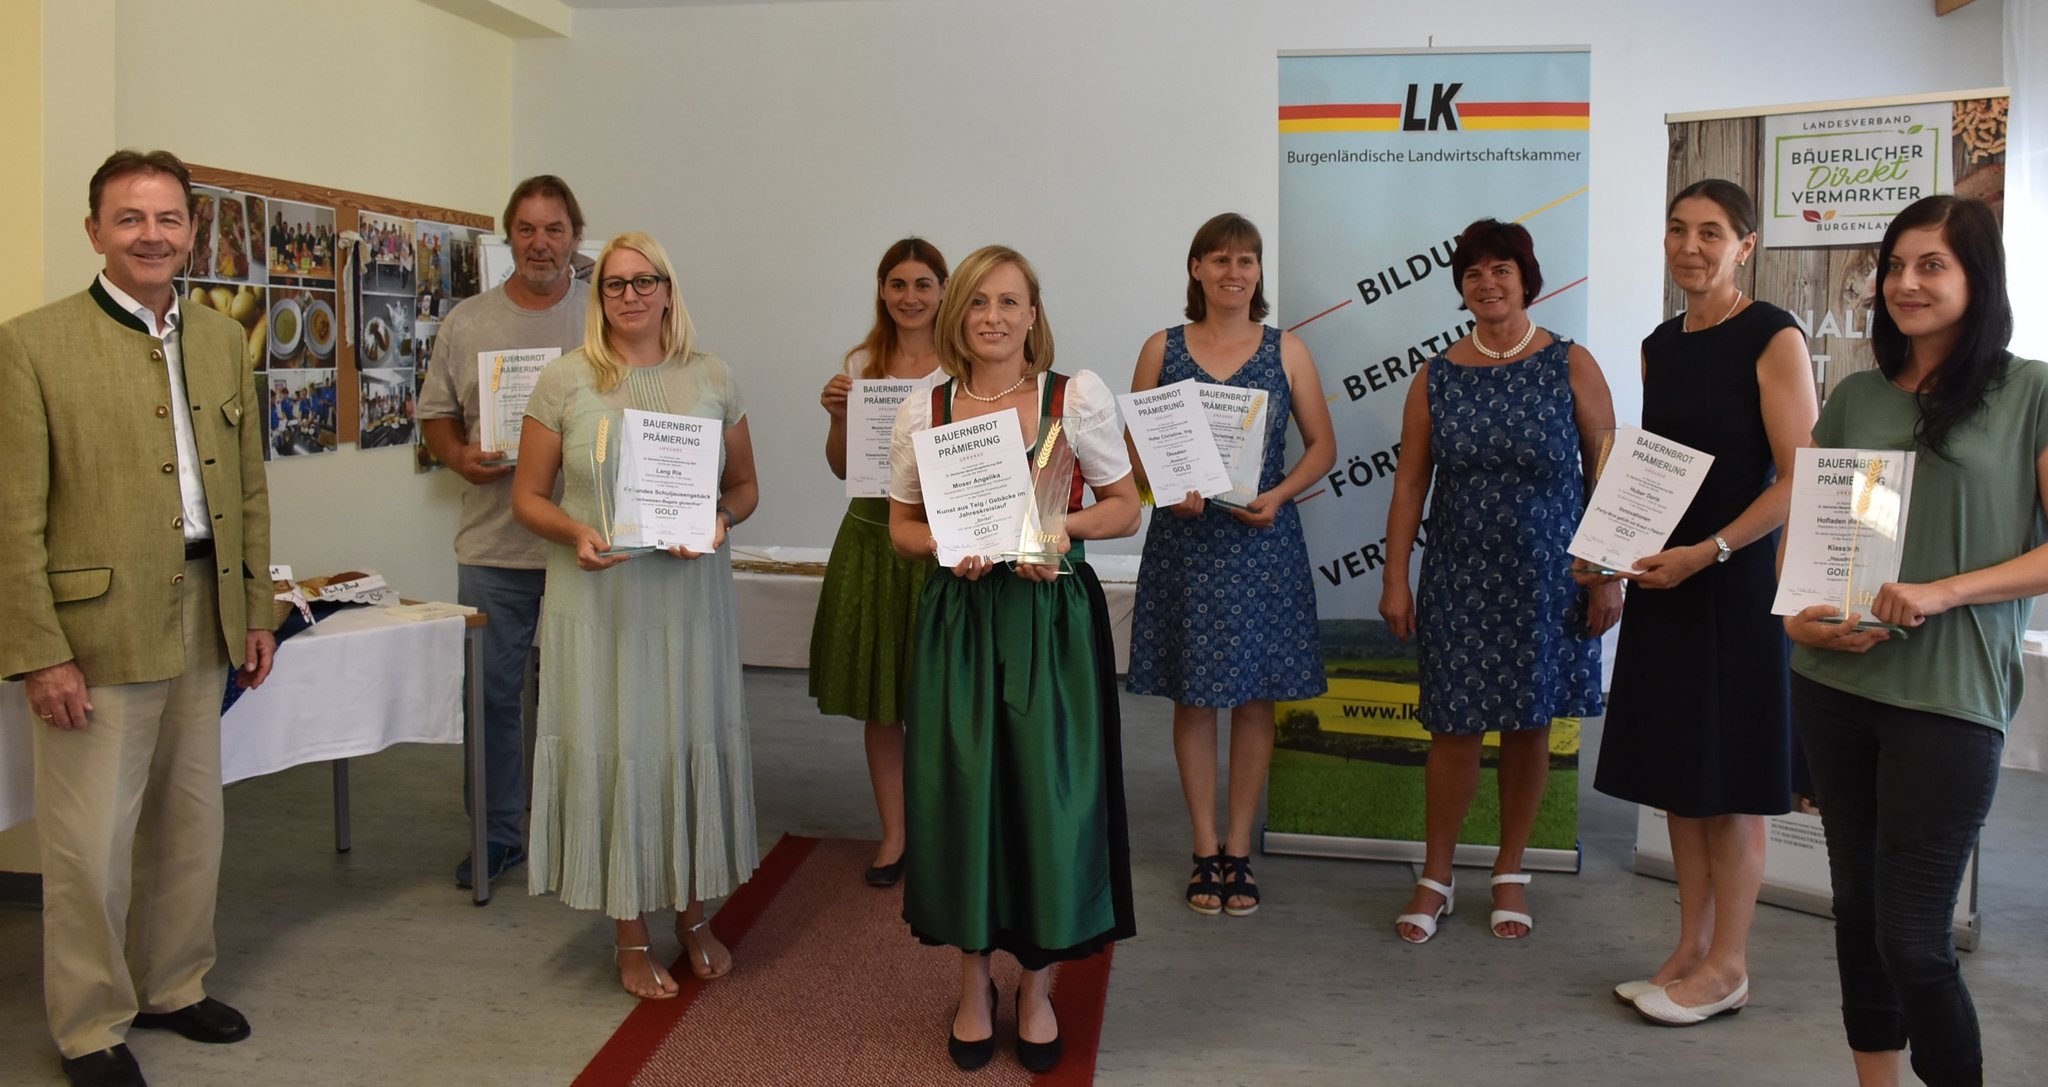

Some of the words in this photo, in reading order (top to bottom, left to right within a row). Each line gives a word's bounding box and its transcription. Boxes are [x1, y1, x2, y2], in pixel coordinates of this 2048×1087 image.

[1402, 83, 1463, 131] LK
[1803, 115, 1911, 130] LANDESVERBAND
[1287, 149, 1404, 166] Burgenländische
[1408, 148, 1581, 164] Landwirtschaftskammer
[1792, 145, 1924, 165] BÄUERLICHER
[1806, 155, 1911, 191] Direkt
[1792, 186, 1921, 205] VERMARKTER
[1816, 221, 1891, 232] BURGENLAN
[1356, 234, 1462, 306] BILDU
[495, 354, 545, 362] UERNBROT
[863, 385, 913, 393] BAUERNBROT
[1199, 389, 1252, 402] BAUERNBROT
[864, 396, 908, 405] PRÄMIERUN
[1133, 389, 1182, 406] BAUERNBROT
[1138, 400, 1185, 416] PRÄMIERUNG
[643, 418, 703, 433] BAUERNBROT
[934, 420, 998, 445] BAUERNBROT
[642, 432, 701, 447] PRÄMIERUNG
[938, 435, 1001, 458] PRÄMIERUNG
[1636, 436, 1695, 464] BAUERNBROT
[1173, 464, 1192, 473] GOLD
[1328, 443, 1401, 498] FÖR
[1632, 450, 1687, 477] PRÄMIERUNG
[1818, 458, 1890, 469] BAUERNBT
[656, 468, 671, 476] Lang
[1818, 472, 1886, 486] PRÄMIEG
[952, 480, 972, 489] Moser
[973, 473, 1001, 484] Angelika
[654, 507, 679, 516] GOLD
[936, 507, 956, 515] Kunst
[957, 504, 969, 512] aus
[970, 500, 984, 509] Teig
[988, 493, 1017, 504] Gebäcke
[958, 502, 1007, 519] Jahreskreislauf
[1817, 517, 1846, 525] Hofladen
[973, 523, 999, 537] GOLD
[1616, 525, 1636, 538] GOLD
[1343, 703, 1421, 720] www.lk
